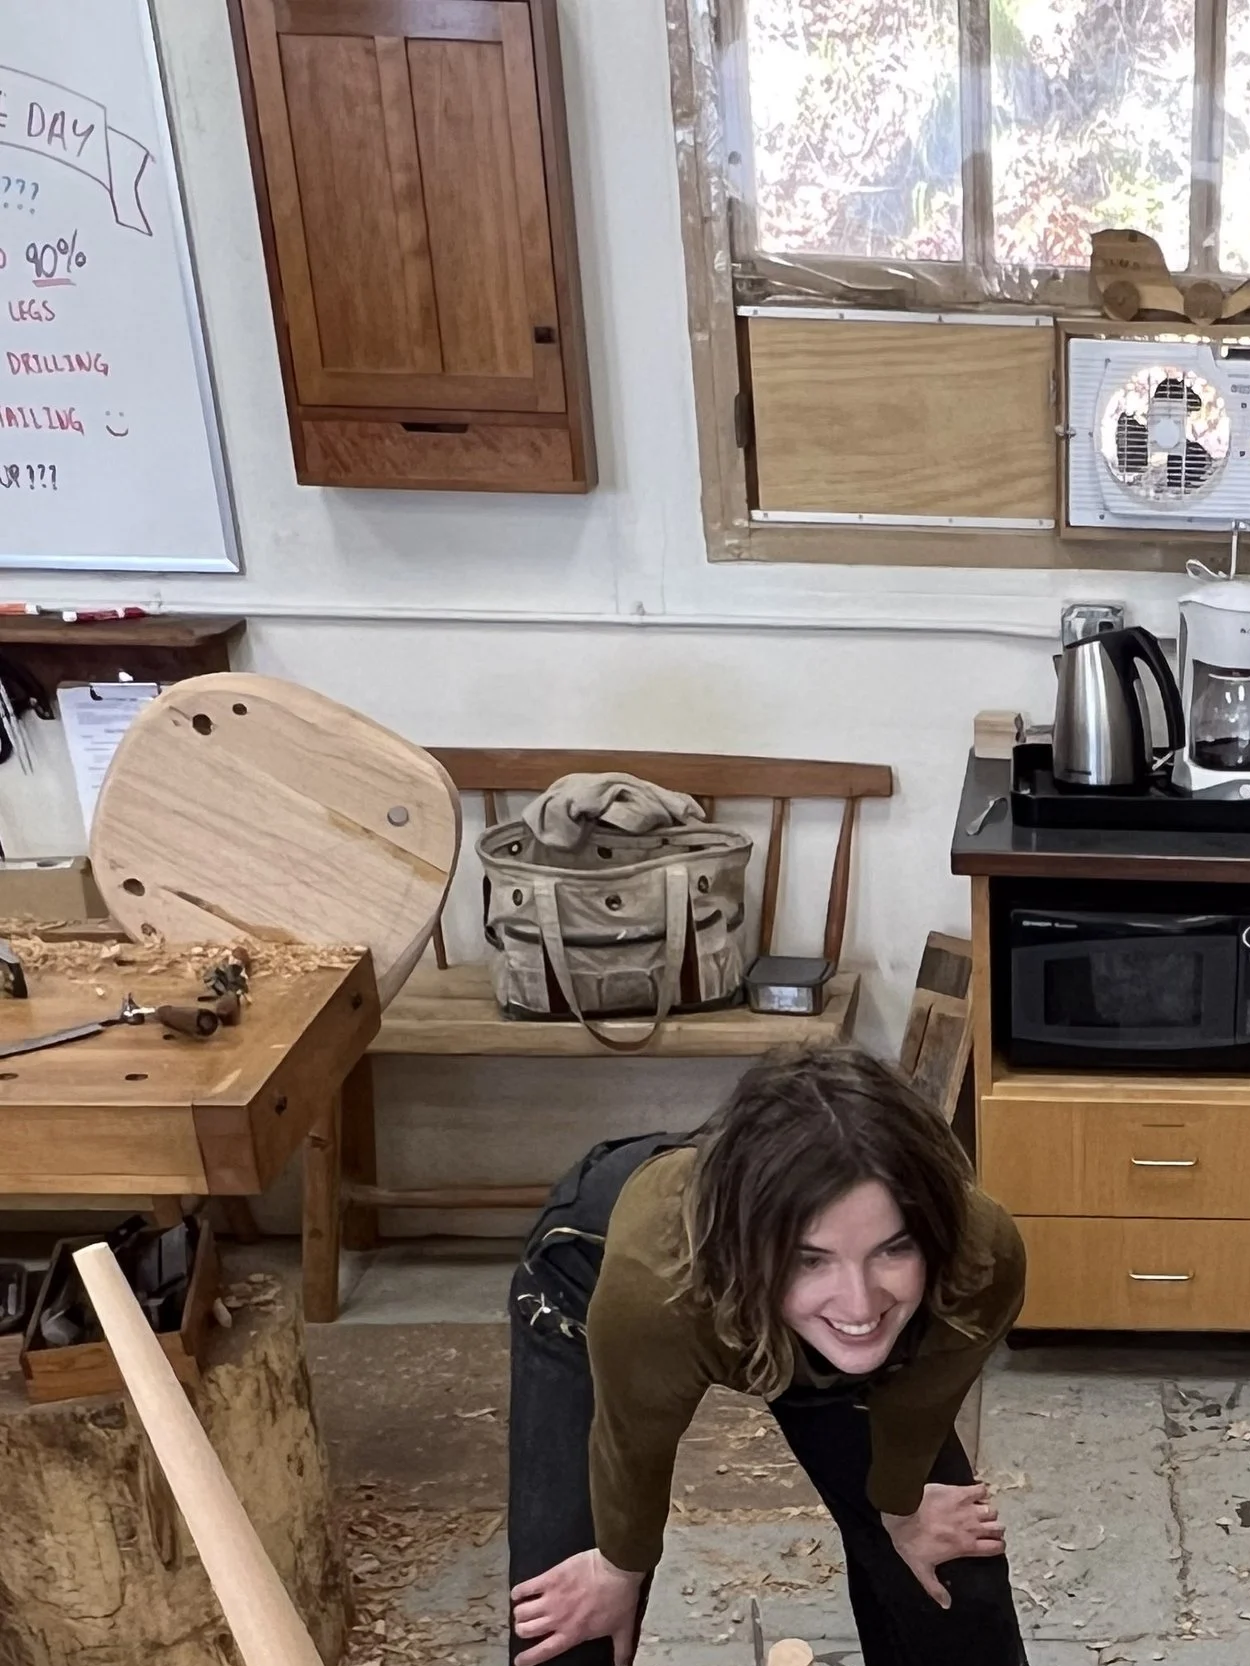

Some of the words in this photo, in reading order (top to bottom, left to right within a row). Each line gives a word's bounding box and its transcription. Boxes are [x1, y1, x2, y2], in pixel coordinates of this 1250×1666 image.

[27, 102, 95, 158] DAY
[25, 228, 87, 278] 90%
[8, 299, 56, 322] LEGS
[6, 351, 109, 377] DRILLING
[0, 406, 85, 436] AILING
